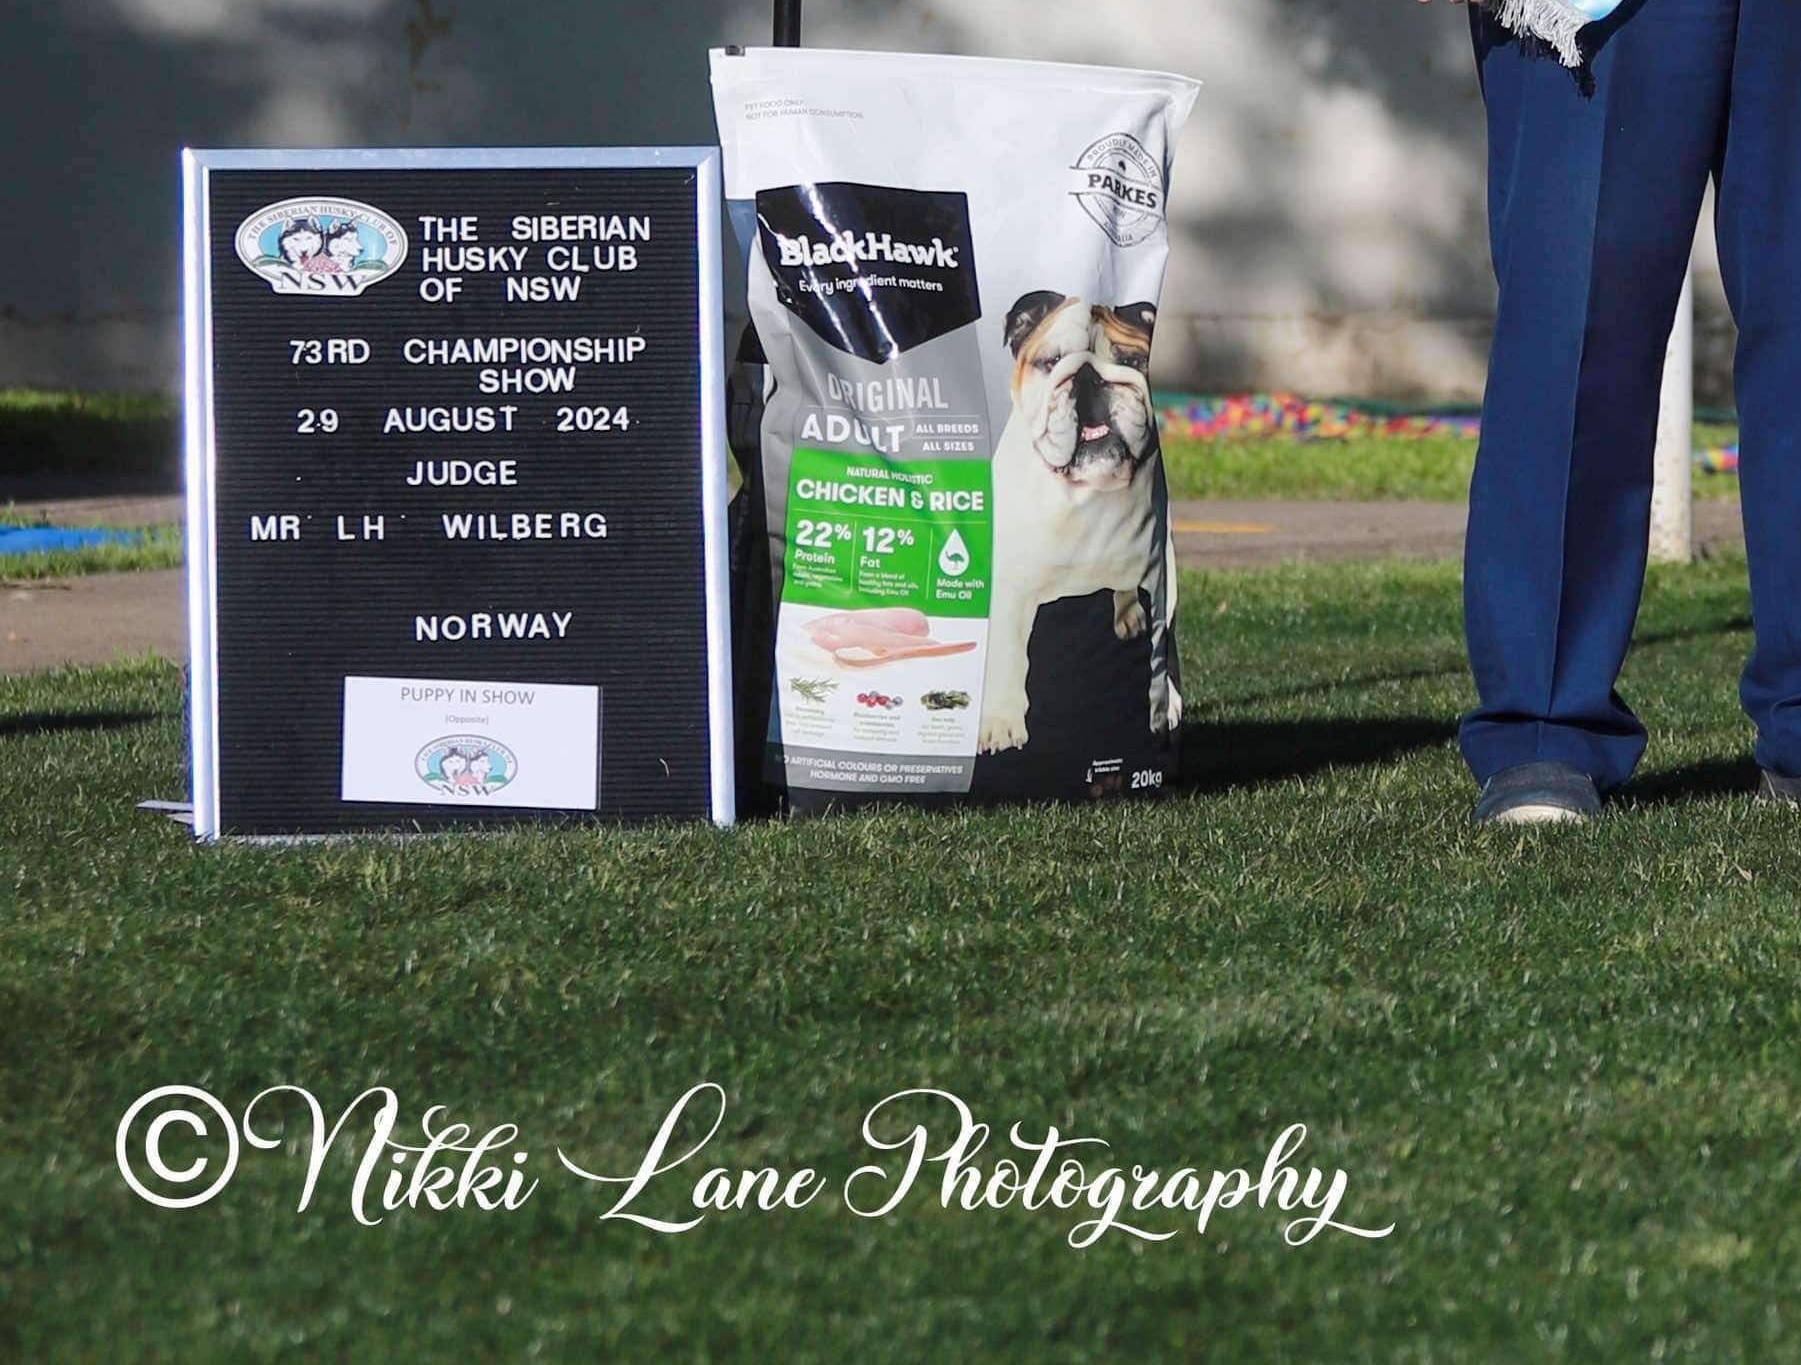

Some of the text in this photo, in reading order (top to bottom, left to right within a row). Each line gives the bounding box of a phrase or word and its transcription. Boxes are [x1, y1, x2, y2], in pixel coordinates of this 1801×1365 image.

[1126, 143, 1150, 166] MADE
[1087, 173, 1158, 209] PARKES
[248, 219, 267, 241] THE
[267, 205, 319, 224] SIBERIAN
[319, 204, 357, 218] HUSKY
[418, 215, 651, 242] THE SIBERIAN
[422, 245, 638, 272] HUSKY CLUB
[779, 229, 959, 269] BlackHawk
[279, 271, 367, 292] NSW
[419, 275, 581, 303] OF NSW
[798, 273, 944, 294] Every ingrdient matters
[289, 336, 647, 365] 73RD CHAMPIONSHIP
[478, 365, 577, 394] SHOW
[826, 372, 949, 413] ORIGINAL
[296, 405, 630, 434] 29 AUGUST 2024
[915, 423, 980, 434] ALL BREEDS
[800, 413, 905, 454] ADULT
[922, 441, 975, 452] ALL SIZES
[406, 460, 518, 486] JUDGE
[846, 466, 934, 485] NATURAL HOLISTIC
[796, 478, 985, 512] CHICKEN & RICE
[250, 512, 608, 541] MR LH WILBERG
[795, 519, 852, 548] 22%
[862, 526, 915, 554] 12%
[794, 549, 835, 565] Protein
[860, 556, 881, 569] Fat
[935, 589, 972, 600] Emu Oil
[936, 577, 985, 589] Made with
[414, 611, 573, 642] NORWAY
[400, 686, 536, 706] PUPPY IN SHOW
[790, 755, 837, 770] ARTIFICIAL
[837, 760, 882, 773] COLOURS
[883, 764, 898, 774] OR
[809, 768, 927, 785] HORMONE AND GMO FREE
[439, 783, 494, 797] NSW
[1131, 768, 1163, 789] 20kg
